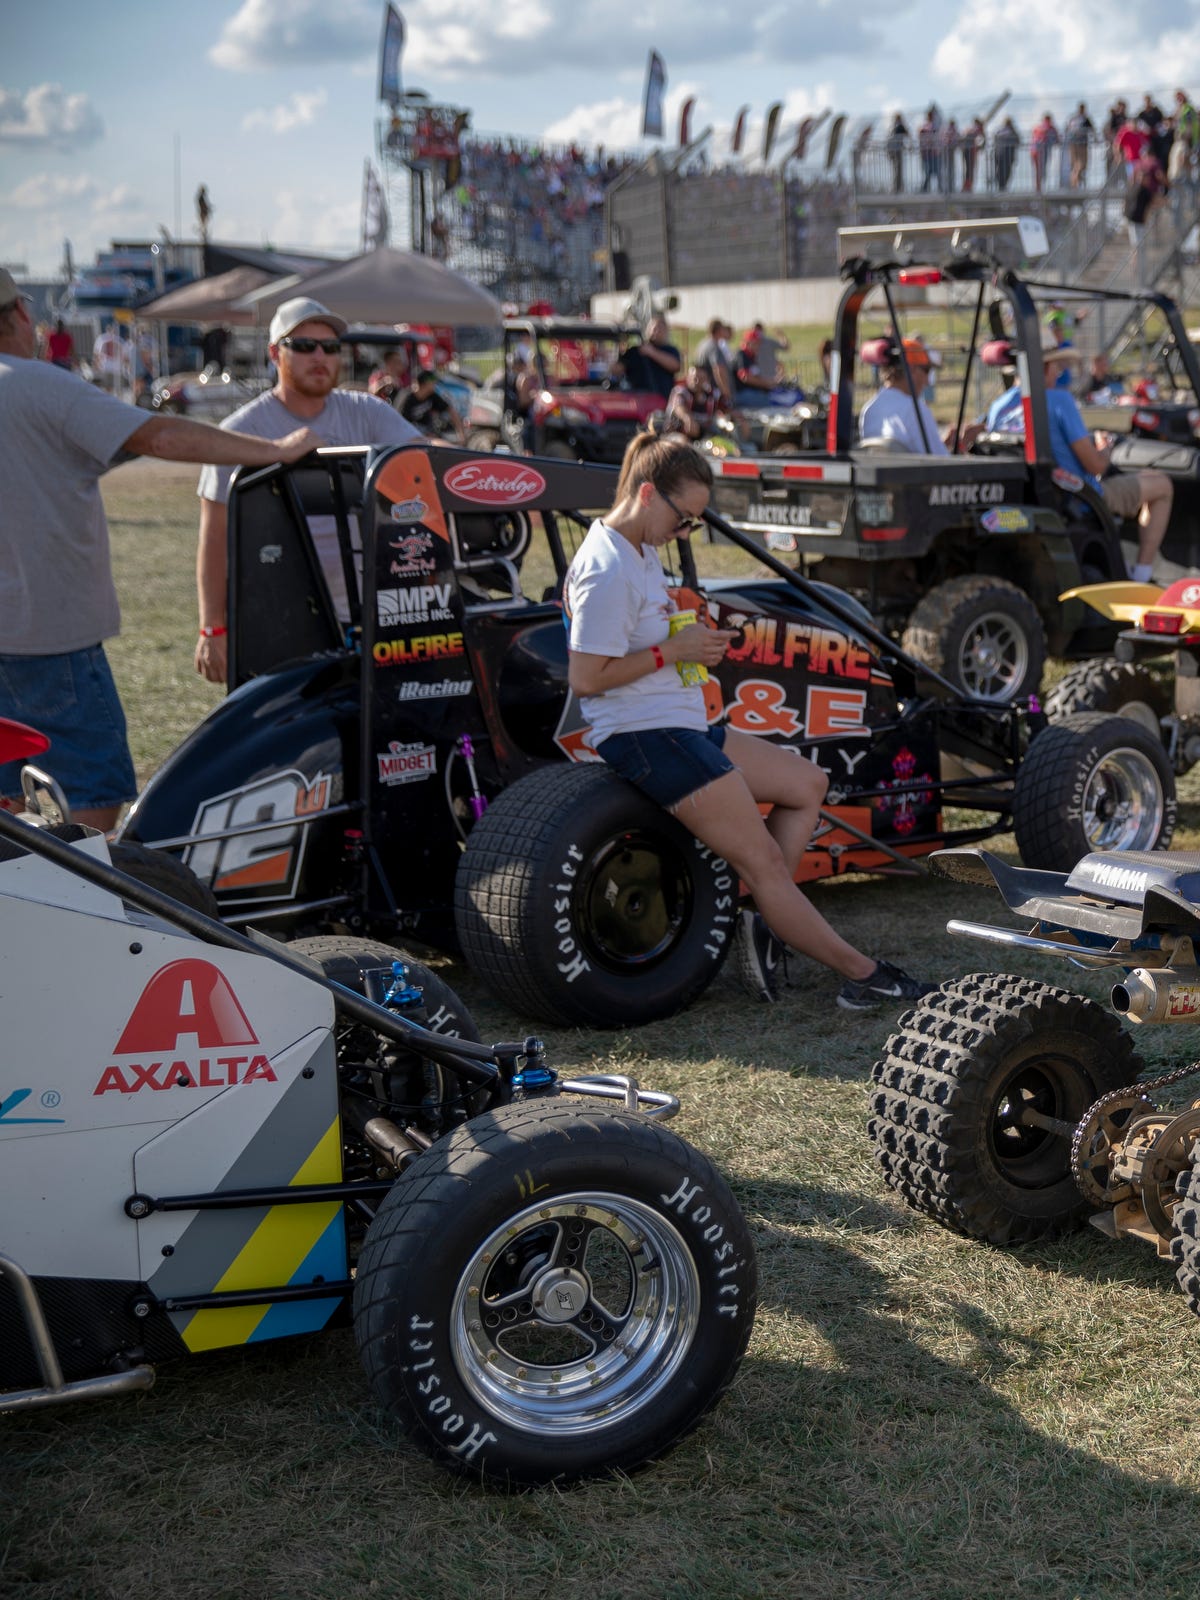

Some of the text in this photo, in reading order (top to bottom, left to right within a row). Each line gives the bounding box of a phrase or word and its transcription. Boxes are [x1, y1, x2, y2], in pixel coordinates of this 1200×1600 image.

[451, 466, 538, 501] Estridge
[929, 483, 1005, 506] ARCTIC CAT
[747, 503, 811, 526] ARCTIC CAT
[399, 583, 452, 613] MPV
[379, 608, 455, 628] EXPRESS INC.
[373, 632, 464, 663] OILFIRE
[724, 618, 871, 682] OILFIRE
[399, 679, 473, 701] iRacing
[380, 752, 432, 777] MIDGET
[1091, 862, 1149, 892] YAMAHA
[549, 843, 592, 983] Hoosier
[92, 1054, 279, 1097] AXALTA
[660, 1176, 742, 1320] Hoosier
[402, 1314, 498, 1459] Hoosier
